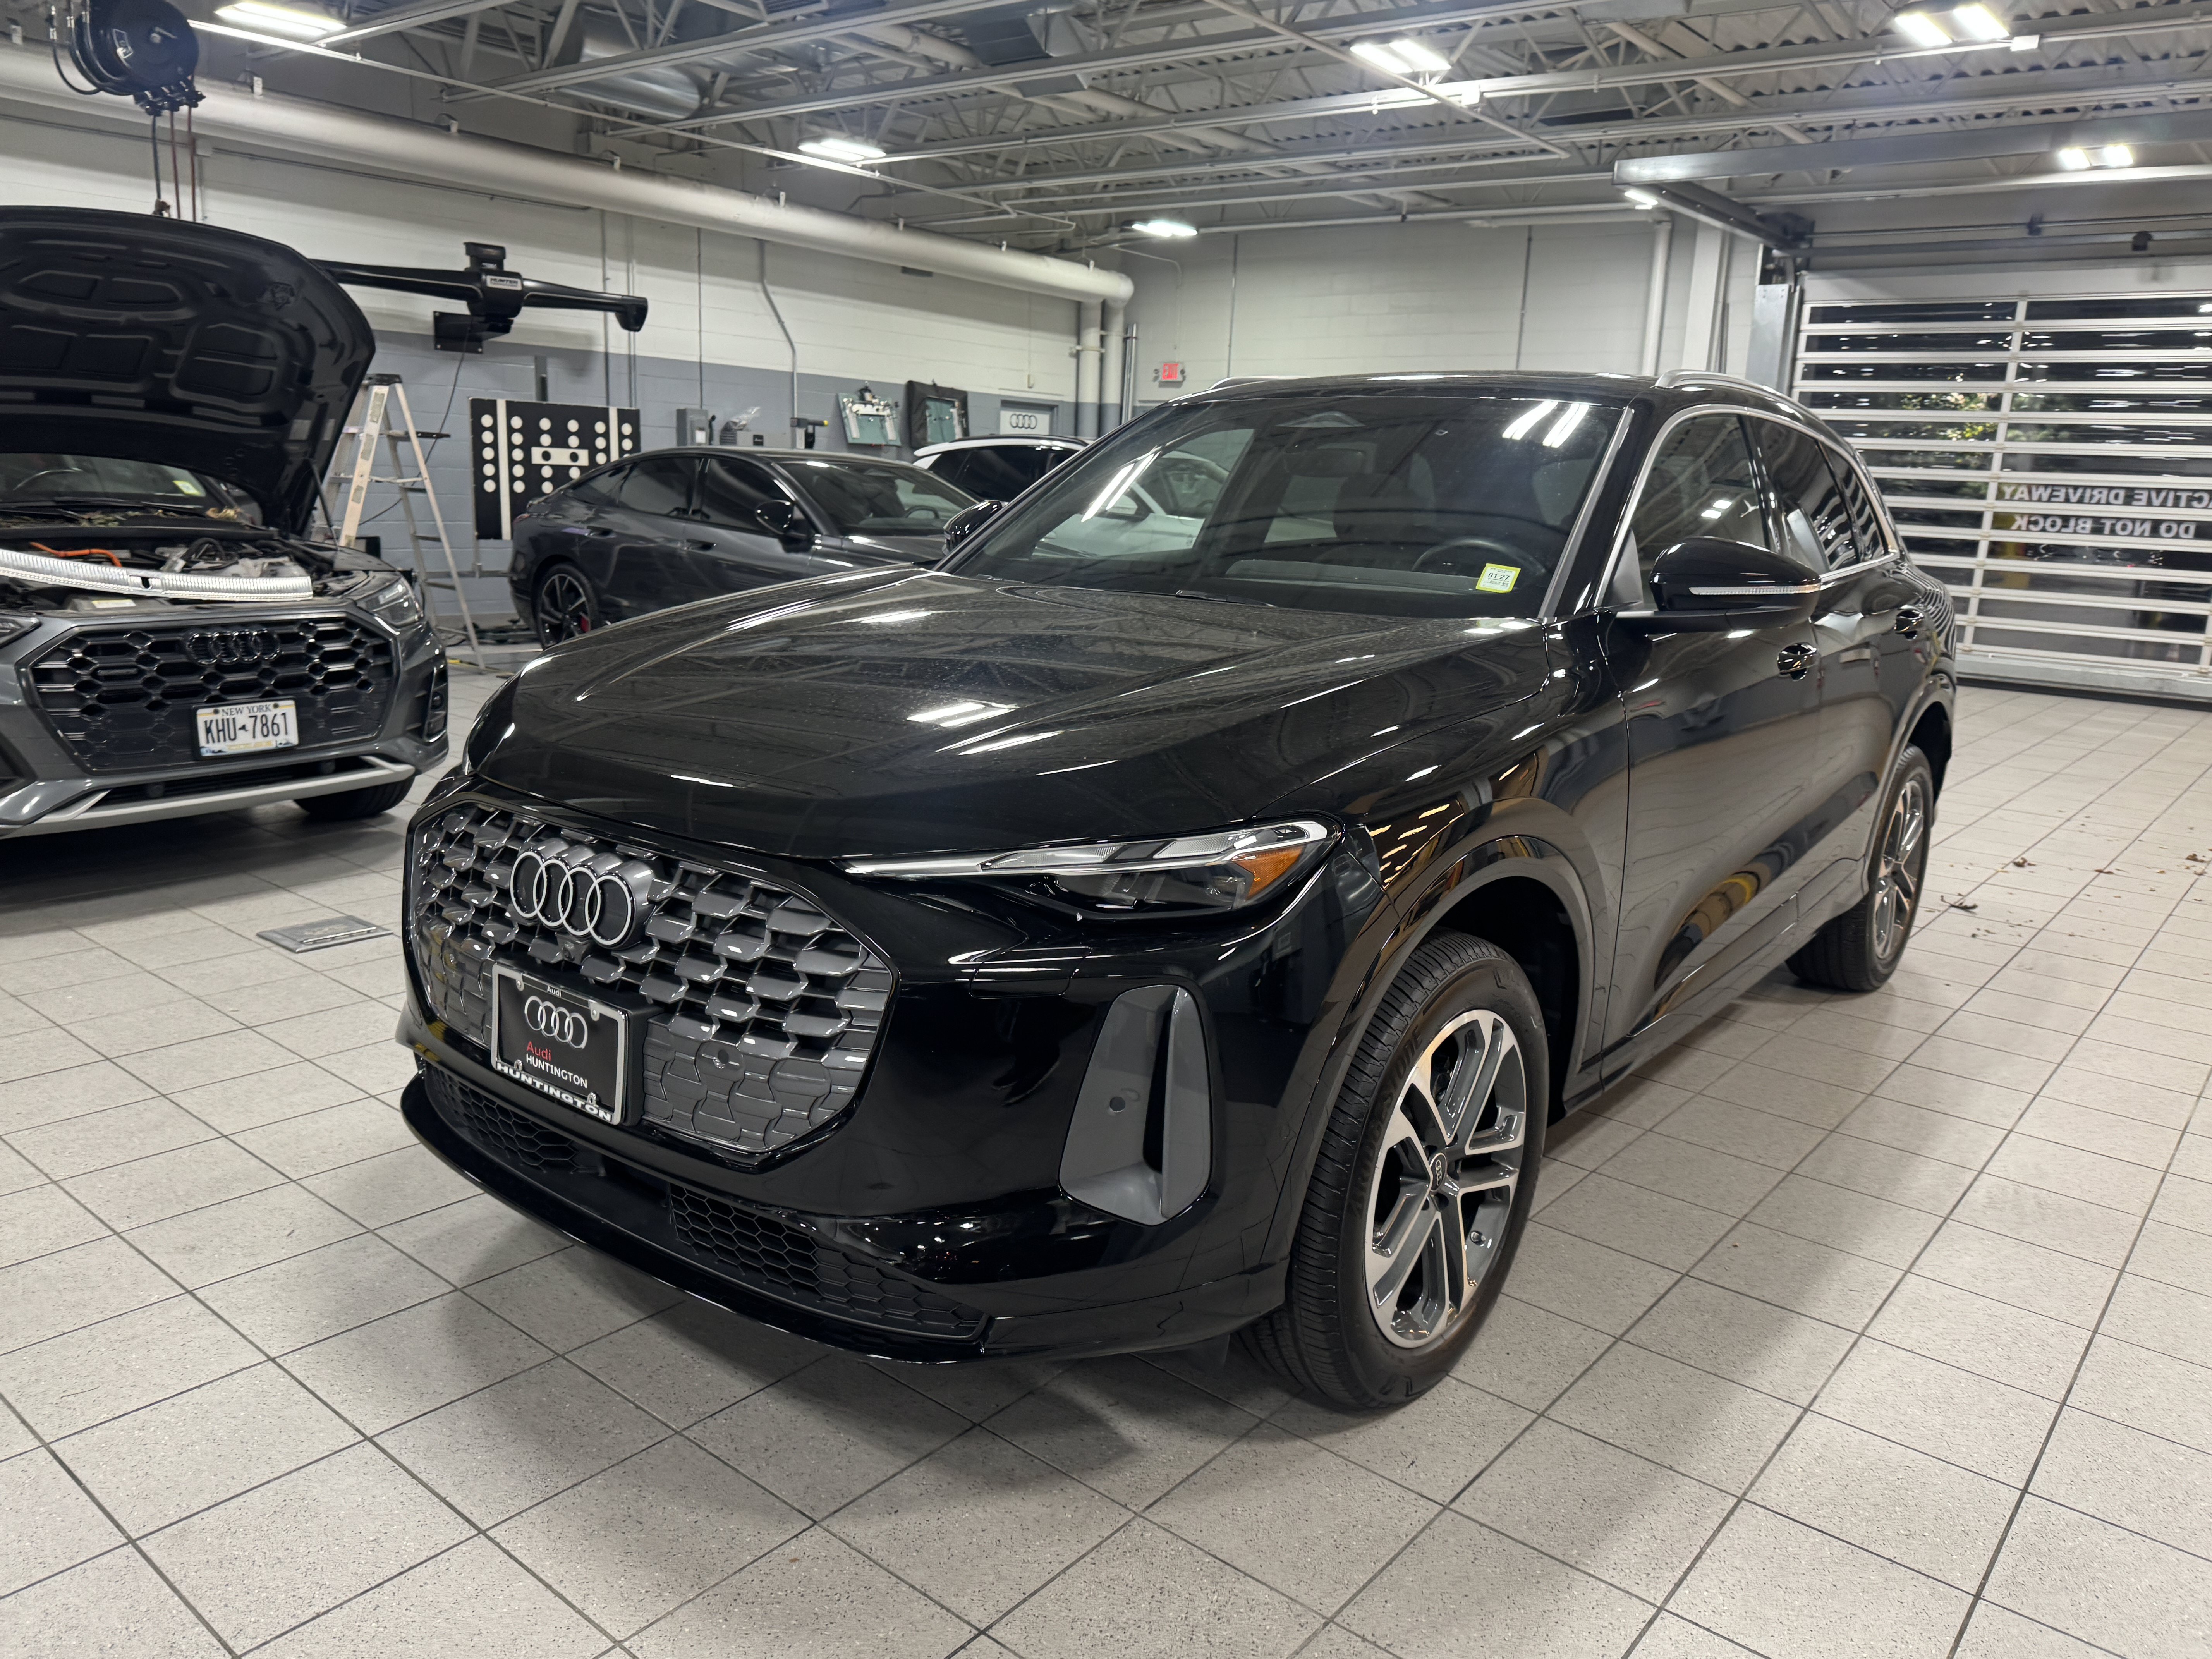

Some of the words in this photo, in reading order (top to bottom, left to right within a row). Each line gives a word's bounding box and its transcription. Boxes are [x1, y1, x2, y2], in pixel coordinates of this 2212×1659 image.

[222, 707, 244, 716] NEW
[247, 704, 271, 713] YORK
[547, 986, 562, 997] Audi
[526, 1041, 551, 1061] Audi
[526, 1054, 587, 1088] HUNTINGTON
[496, 1062, 613, 1122] HUNTINGTON
